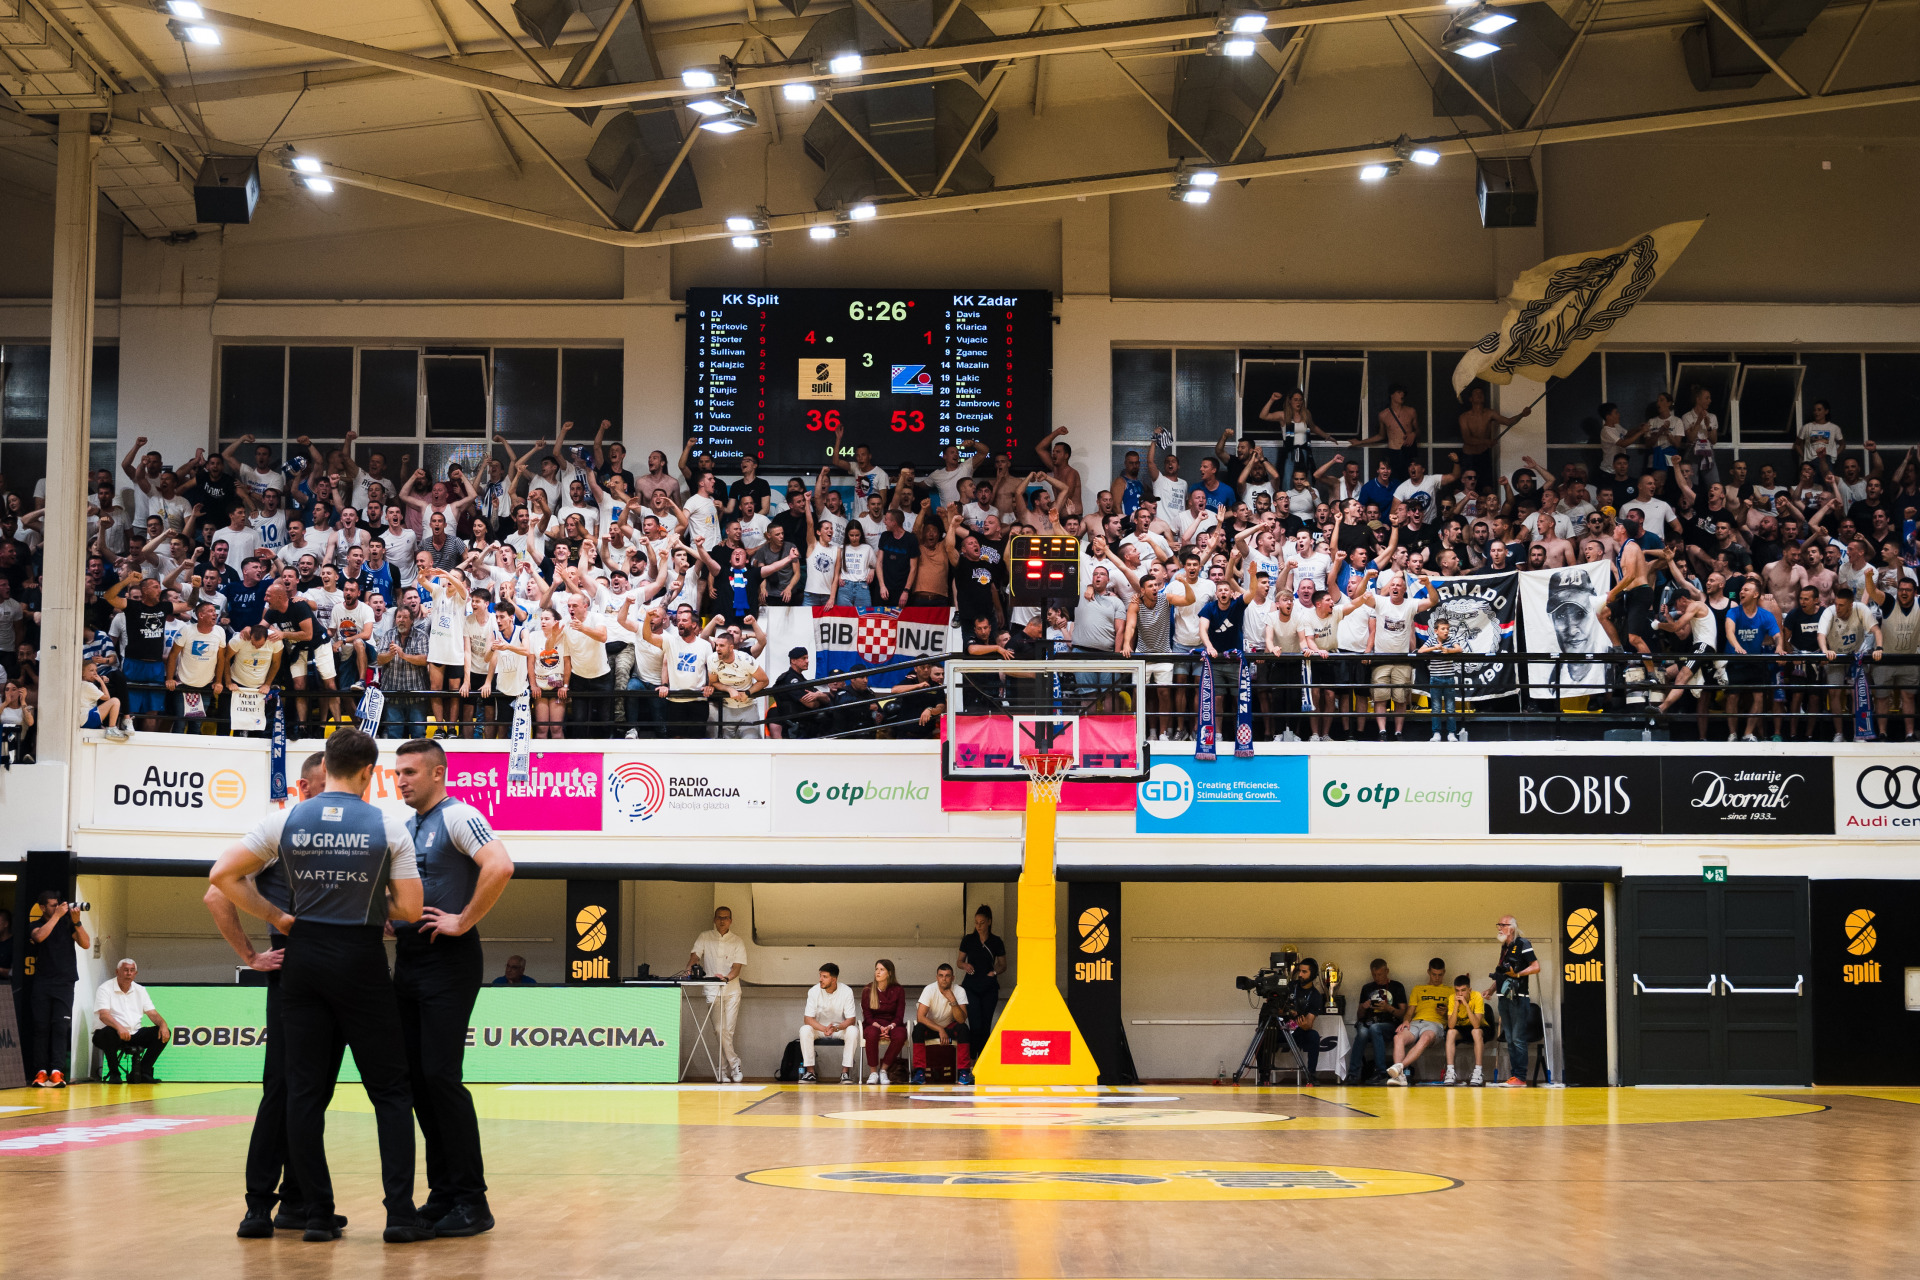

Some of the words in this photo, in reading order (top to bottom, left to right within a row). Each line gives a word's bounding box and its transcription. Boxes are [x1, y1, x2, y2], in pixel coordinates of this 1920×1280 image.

[722, 294, 743, 305] KK
[747, 294, 779, 307] Split
[953, 295, 974, 306] KK
[977, 295, 1017, 306] Zadar
[699, 310, 705, 318] 0
[711, 310, 723, 318] DJ
[760, 311, 766, 319] 3
[849, 301, 907, 321] 6:26
[1006, 311, 1013, 320] 0
[760, 324, 766, 332] 7
[945, 323, 951, 331] 6
[956, 323, 987, 331] Klarica
[1006, 324, 1013, 332] 0
[760, 336, 766, 344] 9
[805, 330, 816, 344] 4
[923, 331, 931, 345] 1
[956, 336, 988, 345] Vujacic
[1006, 337, 1013, 345] 0
[760, 349, 766, 357] 5
[945, 348, 951, 356] 9
[956, 348, 988, 357] Zganec
[1006, 349, 1012, 358] 3
[710, 361, 745, 369] Kalajzic
[759, 362, 766, 370] 2
[862, 353, 874, 367] 3
[941, 361, 951, 369] 14
[956, 361, 989, 369] Mazalin
[1006, 362, 1012, 370] 9
[759, 374, 765, 383] 9
[956, 374, 980, 382] Lakic
[1006, 375, 1013, 383] 5
[698, 386, 704, 394] 8
[709, 386, 737, 395] Runjic
[760, 387, 764, 396] 1
[811, 382, 833, 394] split
[1006, 388, 1013, 396] 5
[694, 399, 704, 407] 10
[709, 399, 735, 407] Kucic
[758, 400, 765, 408] 0
[1006, 400, 1012, 409] 0
[758, 412, 765, 421] 0
[806, 409, 841, 432] 36
[890, 410, 925, 432] 53
[939, 412, 950, 420] 24
[956, 412, 994, 421] Dreznjak
[1006, 413, 1012, 421] 4
[758, 425, 765, 434] 0
[939, 425, 950, 433] 26
[955, 425, 980, 433] Grbic
[1006, 426, 1012, 434] 0
[709, 437, 733, 445] Pavin
[758, 438, 764, 446] 0
[1006, 438, 1017, 447] 21
[758, 451, 764, 459] 0
[261, 524, 277, 542] 10
[820, 623, 853, 645] BIB
[898, 627, 944, 652] INJE
[1842, 633, 1856, 646] 29
[143, 765, 204, 788] Auro
[444, 767, 498, 787] Last
[669, 777, 709, 787] RADIO
[1733, 770, 1782, 783] zlatarije
[1142, 780, 1189, 802] GDi
[1197, 781, 1232, 790] Creating
[1233, 781, 1280, 789] Efficiencies.
[1691, 770, 1805, 809] Dvornik
[113, 784, 204, 809] Domus
[506, 785, 547, 798] RENT
[550, 785, 562, 798] A
[565, 785, 597, 798] CAR
[669, 787, 741, 798] DALMACIJA
[826, 780, 930, 806] otpbanka
[1197, 791, 1244, 800] Stimulating
[1245, 791, 1278, 799] Growth.
[1357, 782, 1400, 810] otp
[1404, 786, 1473, 808] Leasing
[1519, 775, 1631, 815] BOBIS
[668, 800, 701, 811] Najbolja
[703, 800, 730, 811] glazba
[1846, 815, 1888, 827] Audi
[312, 833, 370, 849] GRAWE
[292, 849, 325, 857] Osiguranje
[334, 849, 351, 857] Vašoj
[572, 955, 611, 981] split
[1075, 957, 1114, 983] split
[1565, 958, 1604, 985] split
[1843, 959, 1882, 985] split
[484, 1027, 502, 1046] U
[510, 1027, 665, 1047] KORACIMA.
[1020, 1038, 1051, 1048] Super
[1022, 1047, 1050, 1057] Sport
